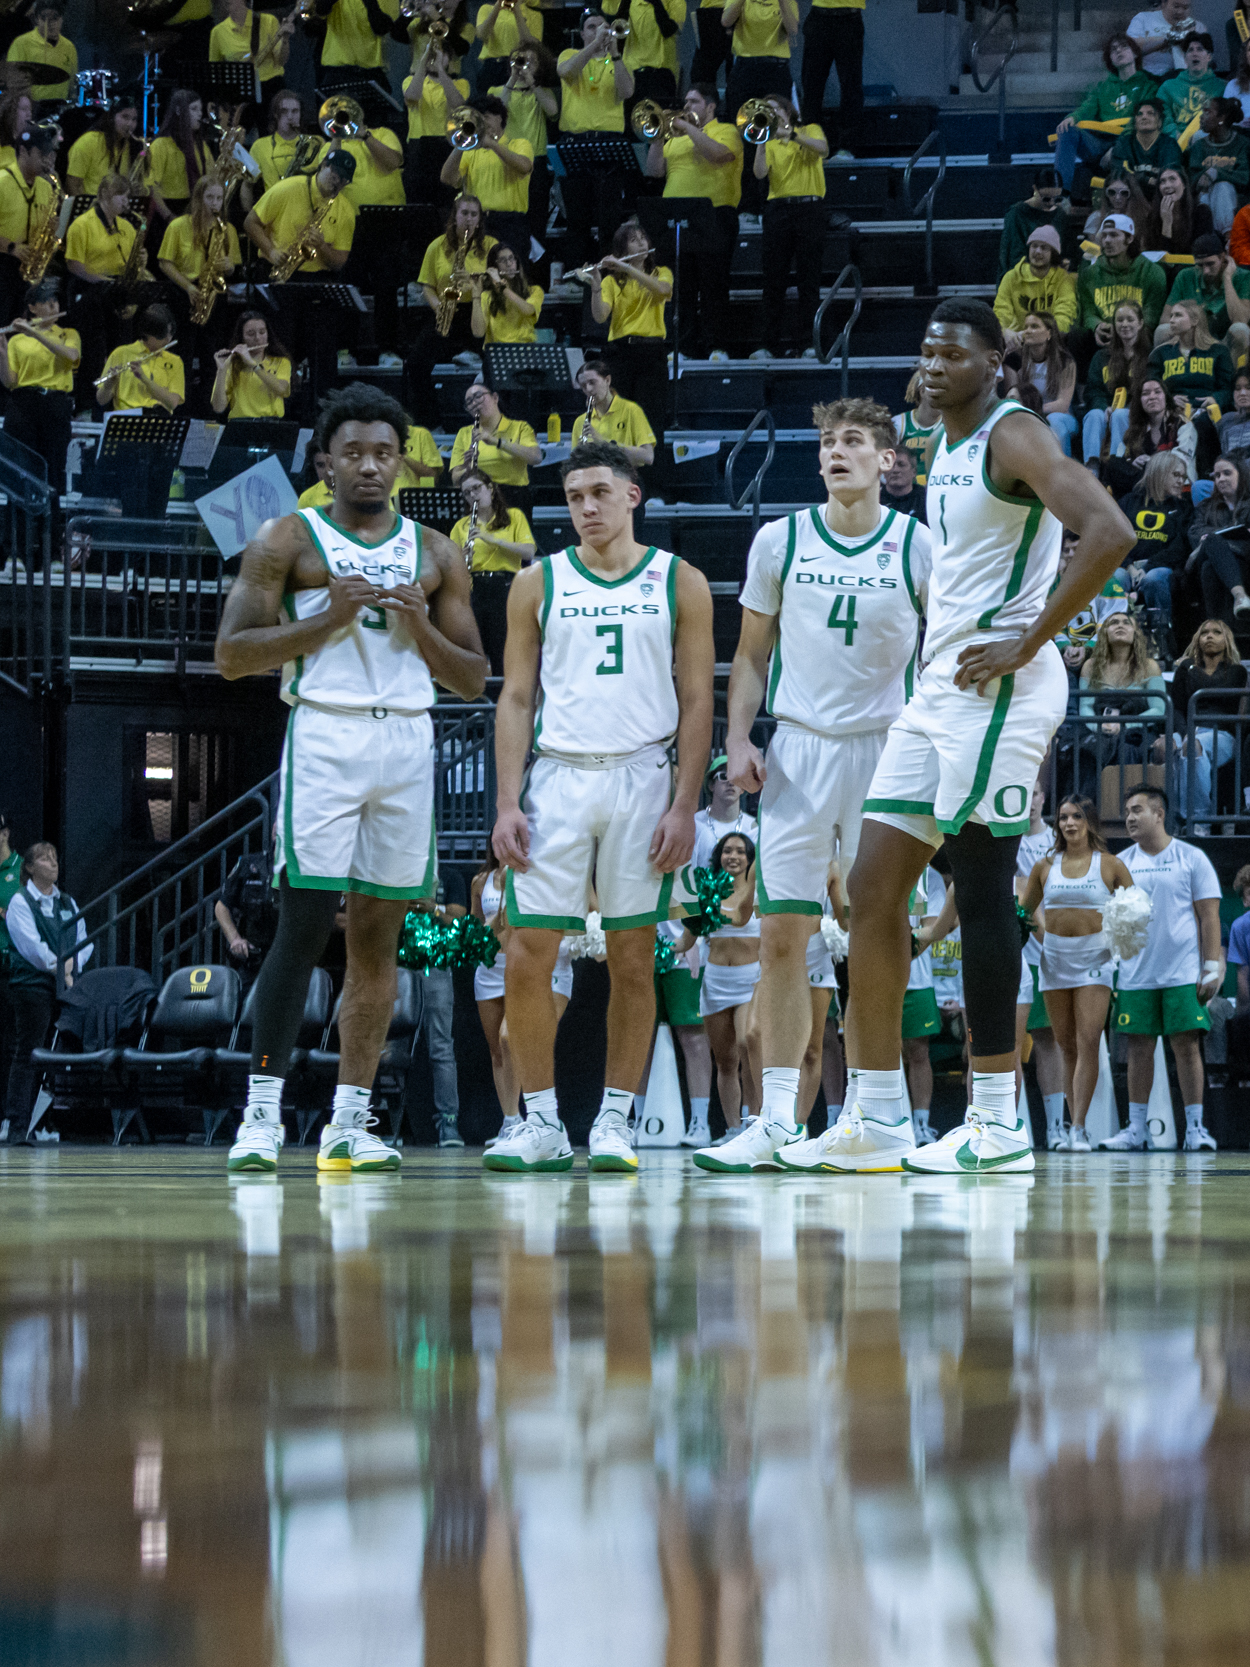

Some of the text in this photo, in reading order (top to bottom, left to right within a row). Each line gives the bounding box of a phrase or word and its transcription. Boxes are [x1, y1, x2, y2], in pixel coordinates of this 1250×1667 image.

[929, 474, 974, 487] DUCKS
[939, 494, 947, 546] 1
[796, 573, 897, 589] DUCKS
[560, 604, 660, 618] DUCKS
[827, 594, 858, 646] 4
[595, 624, 623, 675] 3
[994, 785, 1028, 817] O
[1131, 866, 1172, 874] OREGON
[645, 1116, 664, 1135] O
